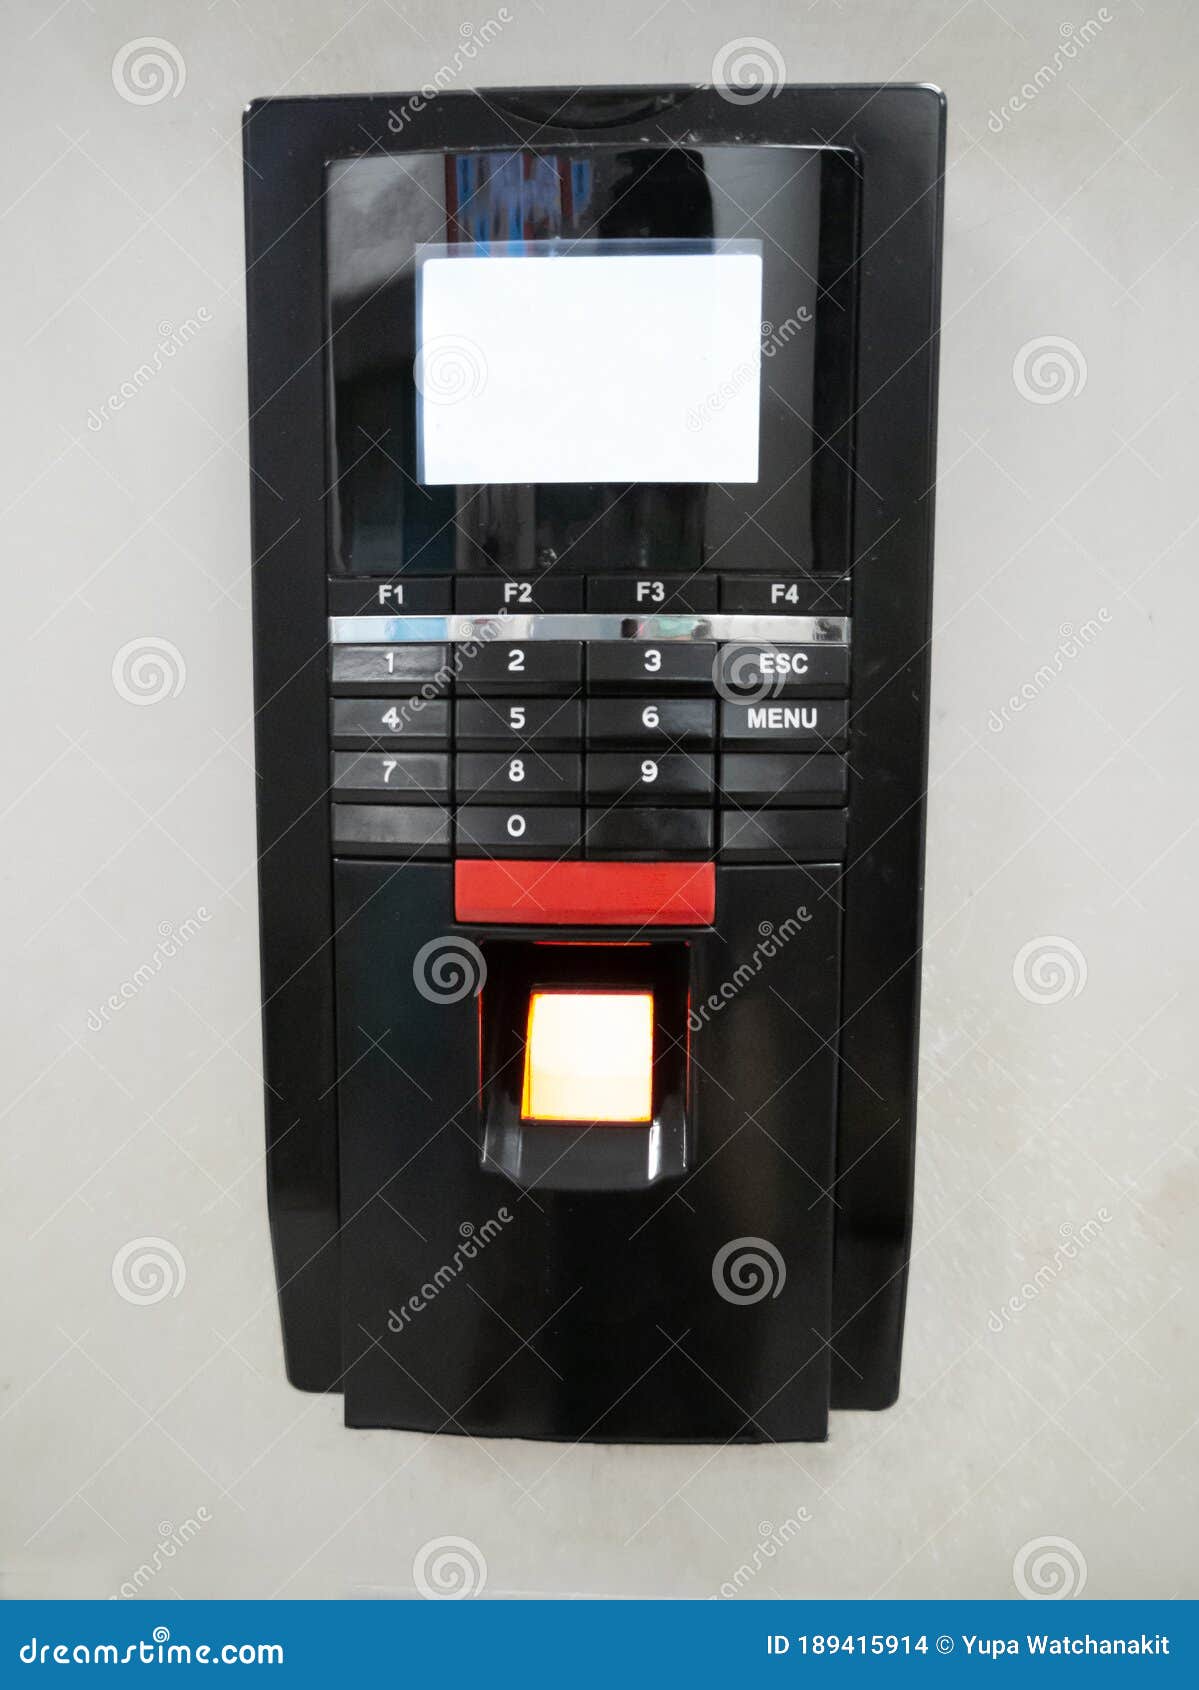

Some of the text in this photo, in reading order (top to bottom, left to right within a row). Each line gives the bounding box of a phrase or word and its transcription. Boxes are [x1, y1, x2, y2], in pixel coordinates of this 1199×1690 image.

[379, 581, 799, 604] F1 F2 F3 F4
[384, 649, 808, 674] 1 2 3 ESC
[382, 706, 817, 729] 4 5 6 MENU
[383, 760, 658, 783] 7 8 9
